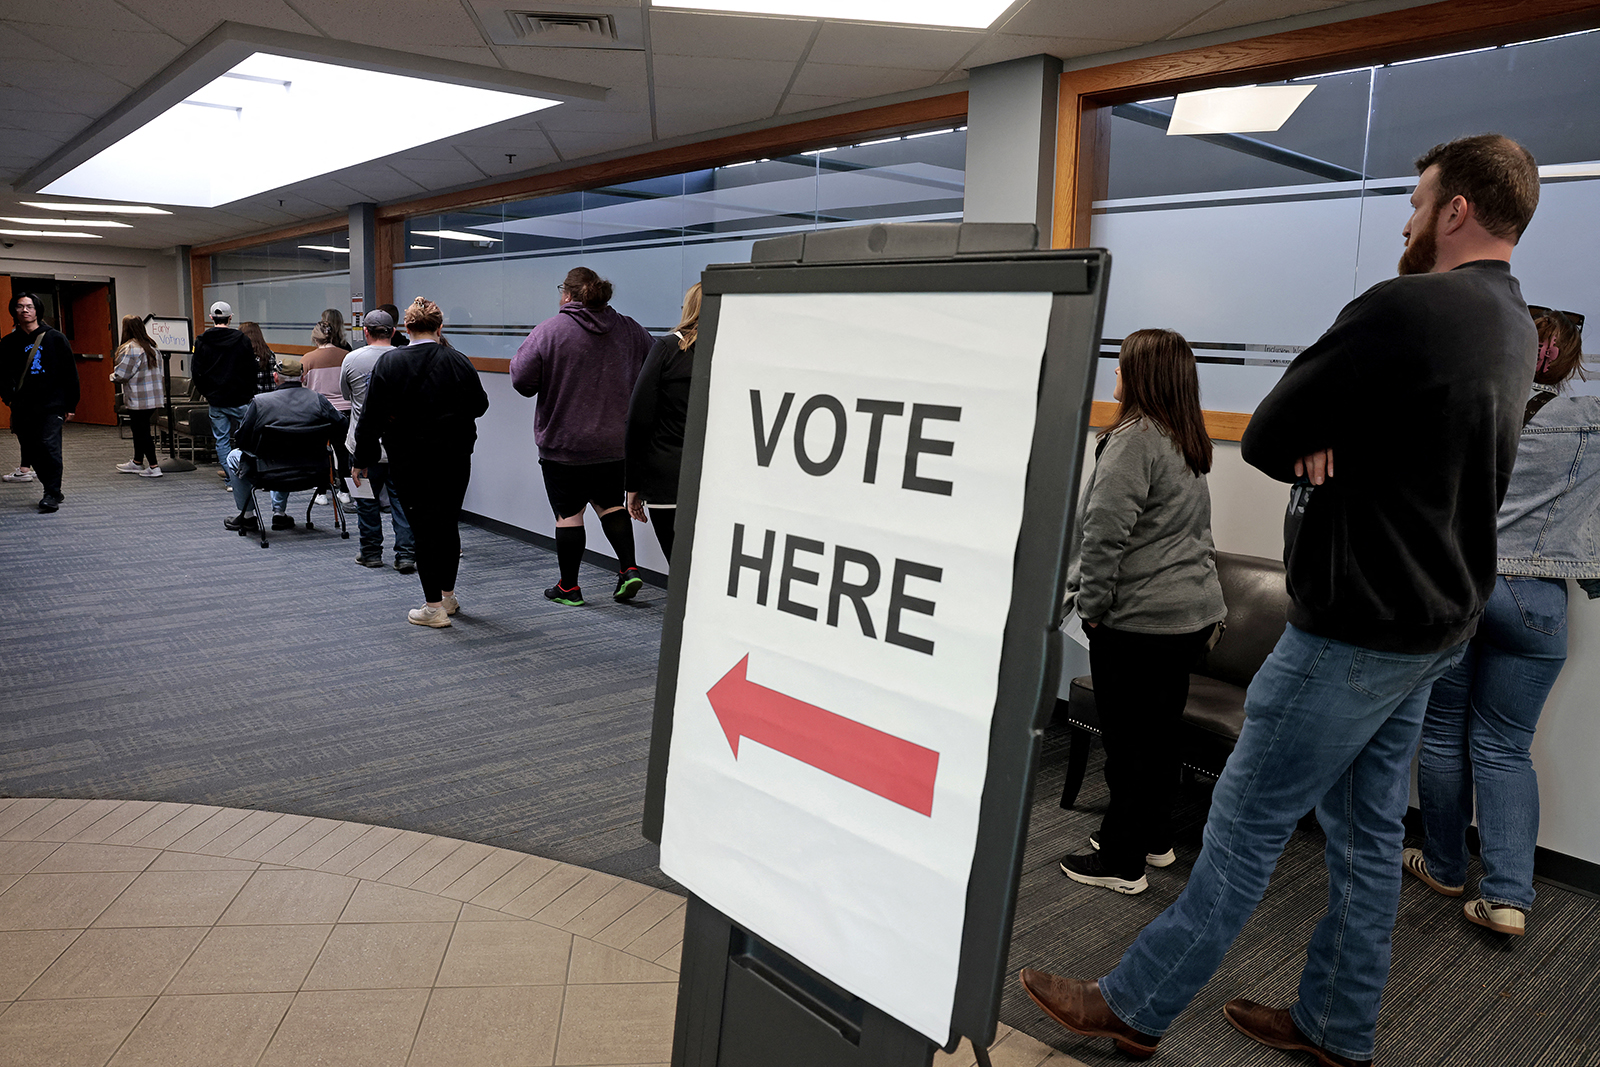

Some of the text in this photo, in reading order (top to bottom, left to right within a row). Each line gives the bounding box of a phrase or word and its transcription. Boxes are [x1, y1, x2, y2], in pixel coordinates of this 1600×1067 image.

[152, 322, 170, 335] Early
[749, 389, 962, 497] VOTE
[727, 522, 943, 656] HERE
